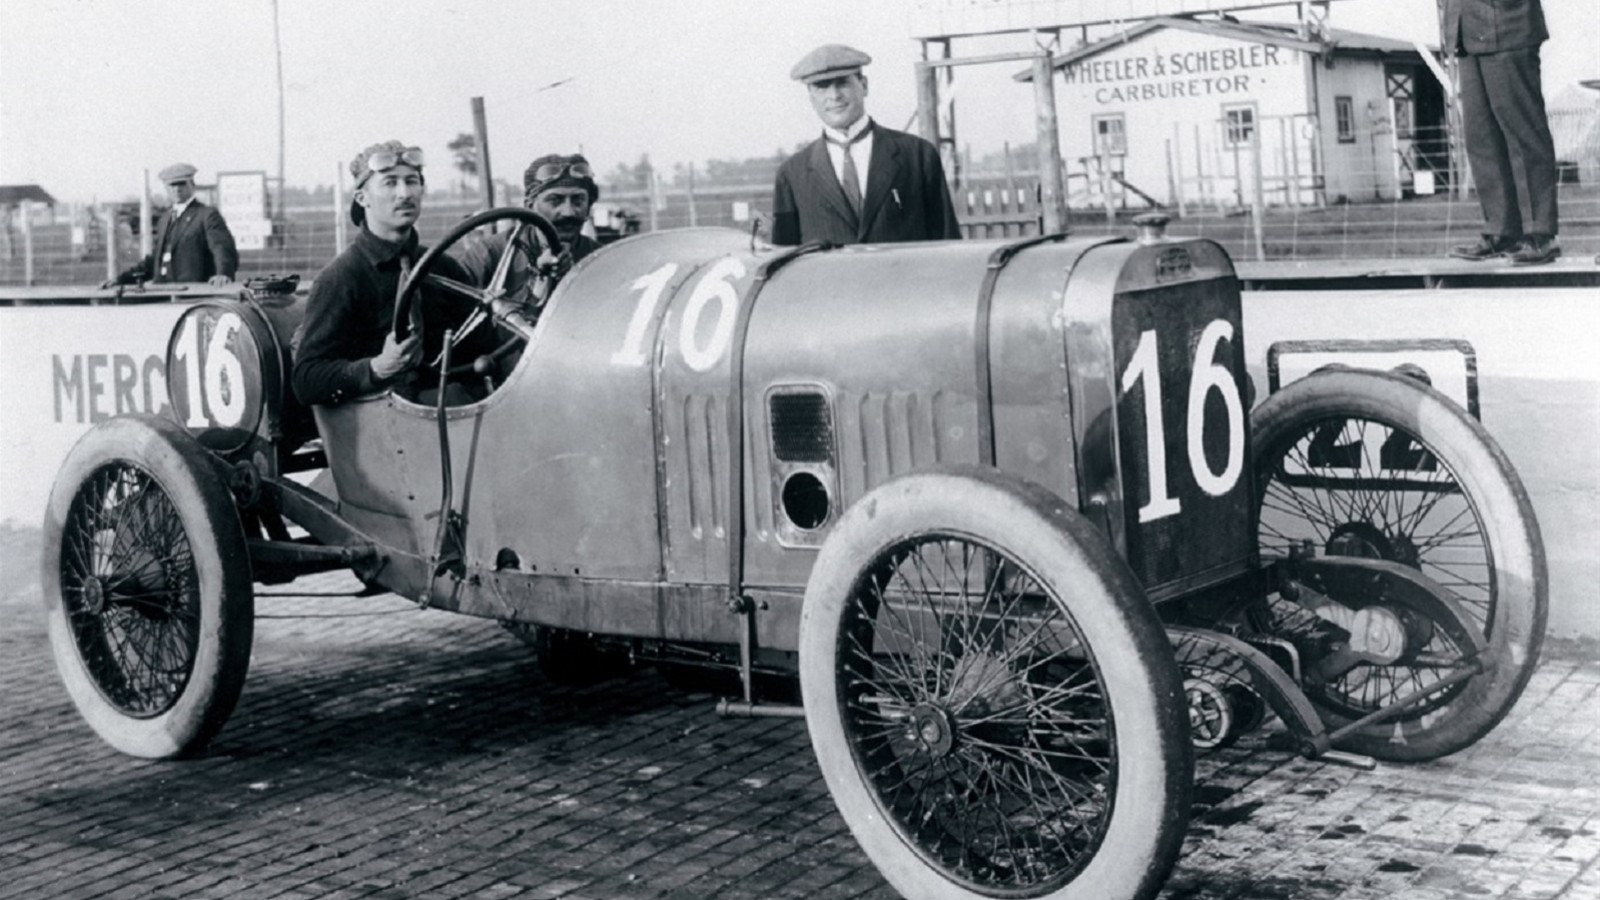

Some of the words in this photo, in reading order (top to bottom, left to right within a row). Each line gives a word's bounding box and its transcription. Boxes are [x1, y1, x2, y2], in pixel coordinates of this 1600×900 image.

[1062, 57, 1149, 84] WHEELER
[1153, 54, 1166, 77] &
[1095, 75, 1250, 104] CARBURETOR
[175, 312, 246, 428] 16
[610, 256, 747, 372] 16
[1122, 318, 1246, 524] 16
